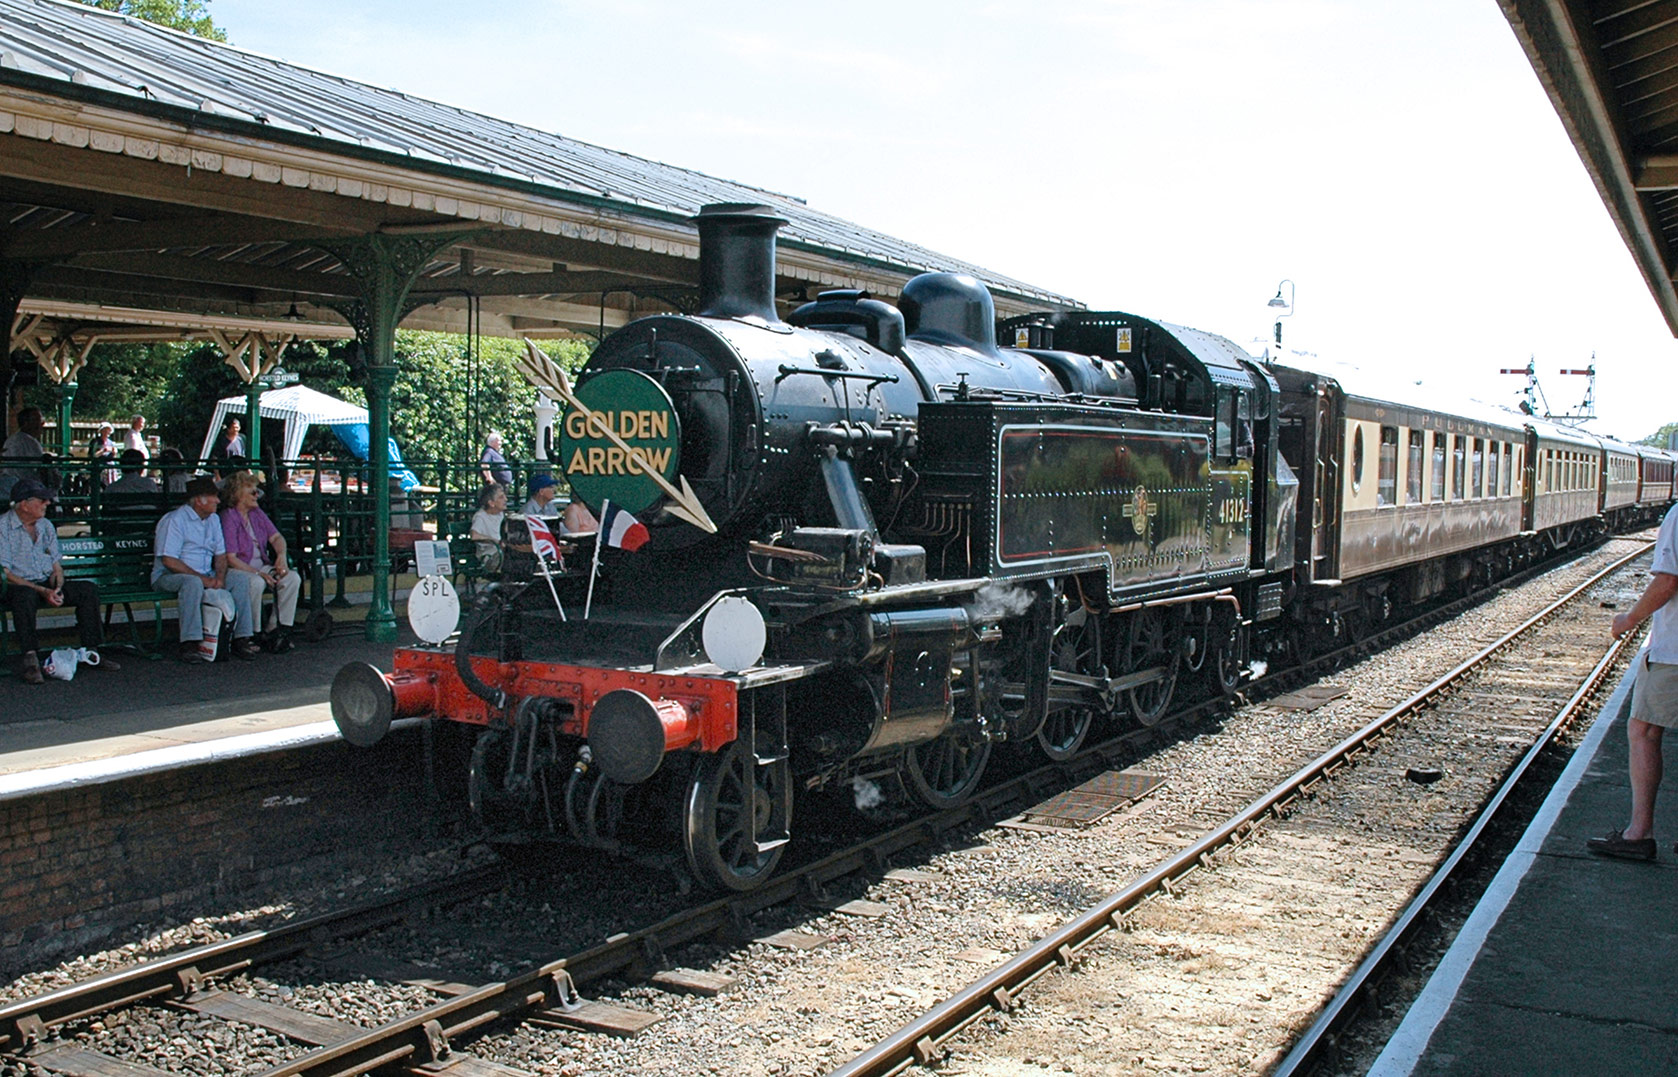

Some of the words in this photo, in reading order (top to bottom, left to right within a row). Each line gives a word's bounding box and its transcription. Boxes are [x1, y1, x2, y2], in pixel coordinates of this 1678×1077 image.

[566, 410, 669, 440] GOLDEN
[1421, 414, 1494, 436] PULLMAN
[567, 446, 673, 476] ARROW
[1218, 498, 1244, 524] 41312
[62, 541, 104, 551] HORSTED
[115, 540, 148, 549] KEYNES
[422, 581, 450, 597] SPL
